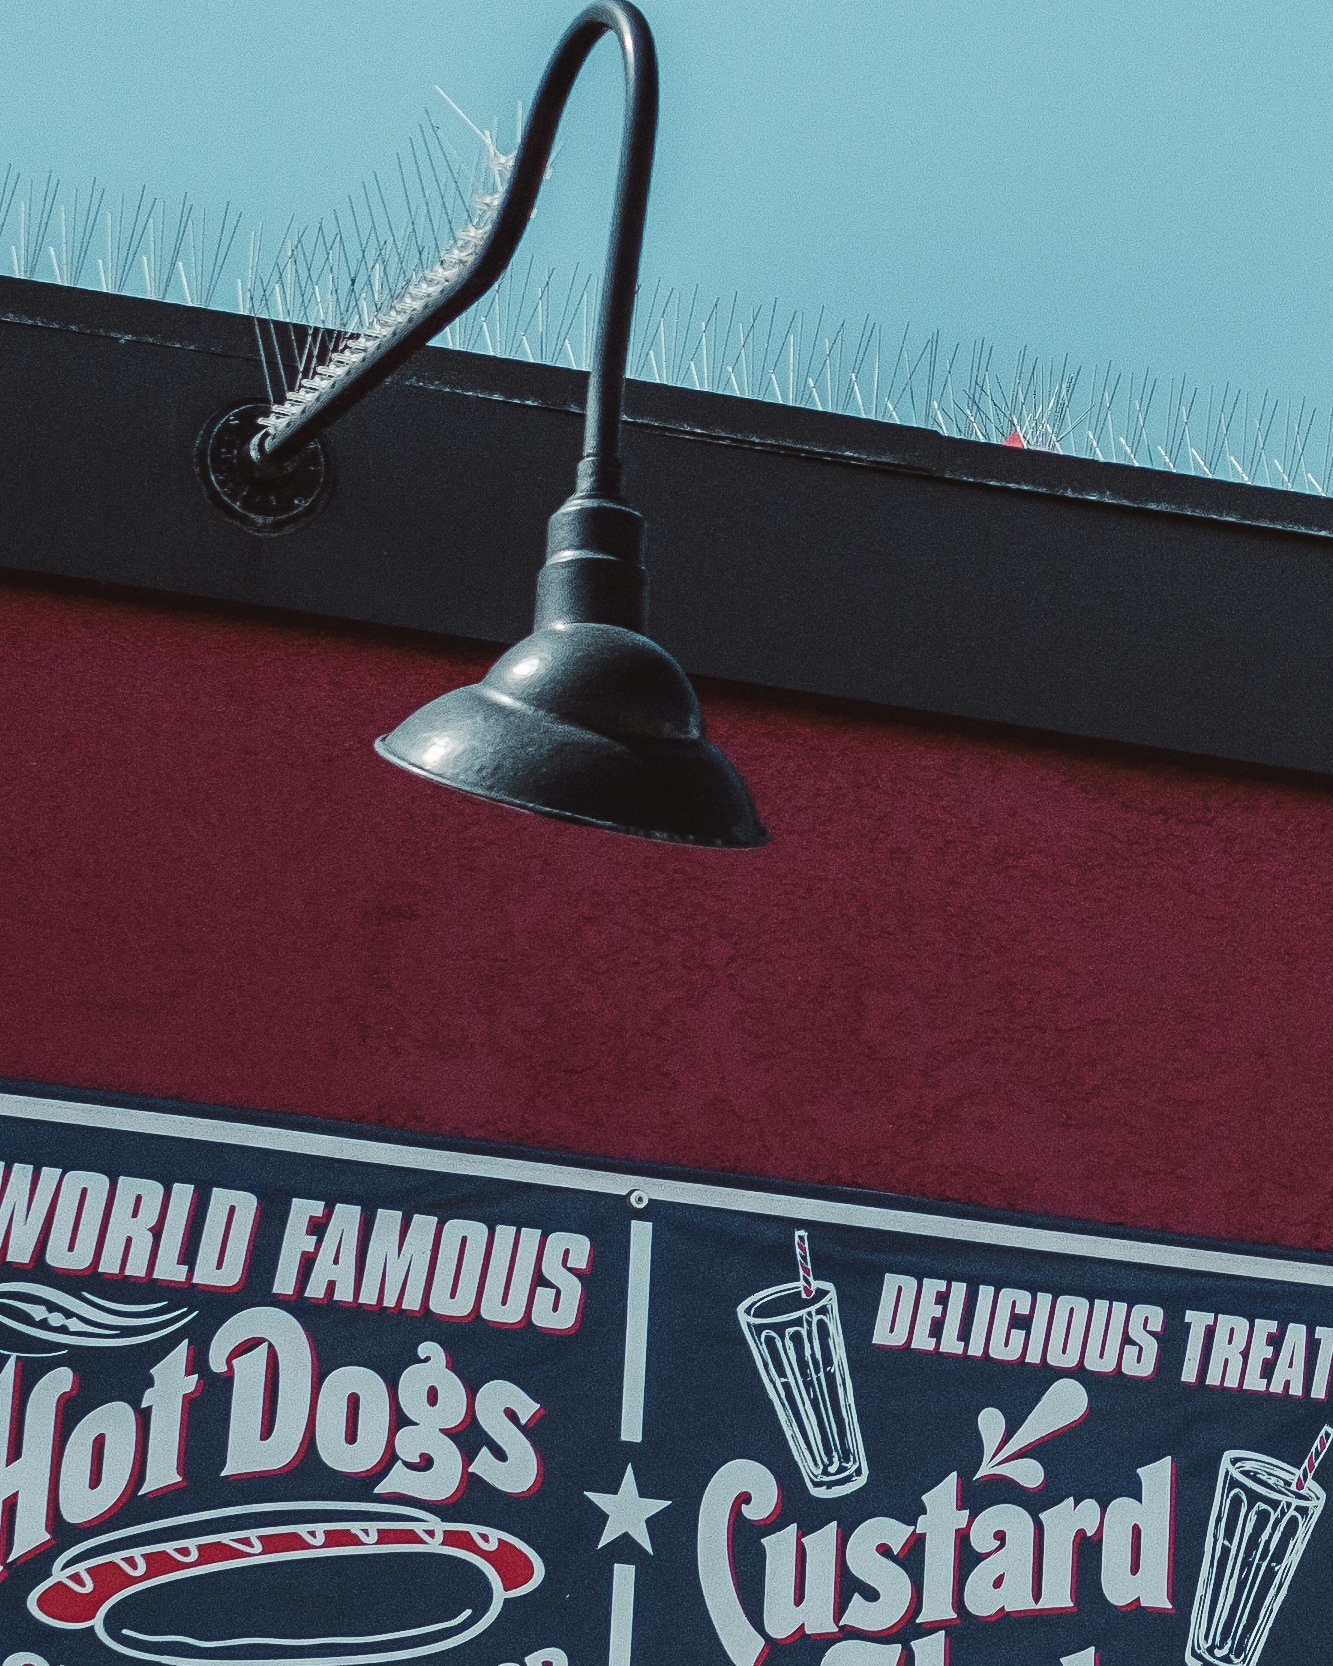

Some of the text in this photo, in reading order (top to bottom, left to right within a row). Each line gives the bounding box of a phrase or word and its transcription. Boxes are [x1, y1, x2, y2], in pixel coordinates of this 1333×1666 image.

[0, 1159, 594, 1335] WORLD FAMOUS
[871, 1273, 1164, 1380] DELICIOUS
[0, 1305, 545, 1573] Hot Dogs
